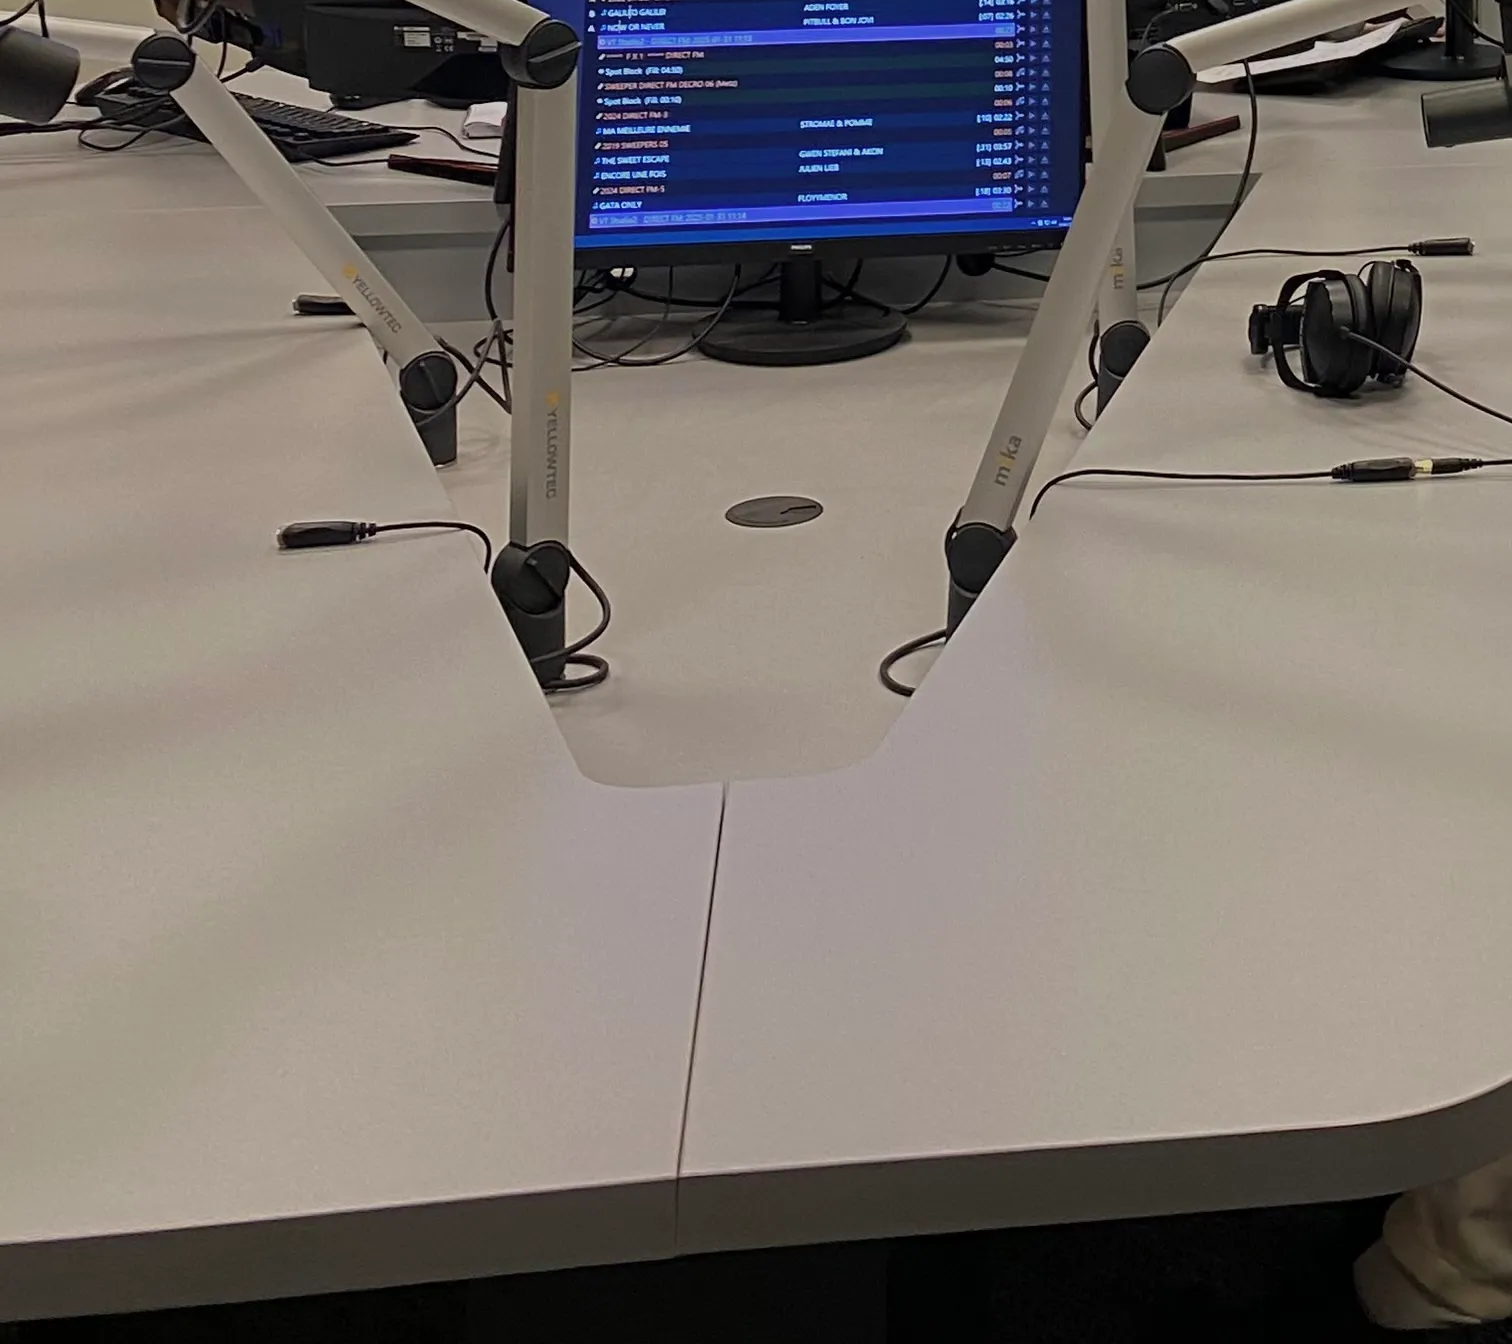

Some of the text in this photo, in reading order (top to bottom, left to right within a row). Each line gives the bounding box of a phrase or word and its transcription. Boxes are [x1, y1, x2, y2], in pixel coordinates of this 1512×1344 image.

[628, 23, 640, 31] OR
[641, 22, 666, 31] NEVER
[665, 51, 705, 60] DIRECT FM
[604, 82, 637, 91] SWEEPER
[638, 81, 665, 90] DIRECT
[665, 80, 678, 89] FM
[622, 112, 648, 120] DIRECT
[603, 127, 616, 136] MA
[617, 156, 641, 165] SWEET
[642, 154, 670, 164] ESCAPE
[601, 170, 631, 180] ENCORE
[619, 185, 645, 194] DIRECT
[599, 200, 643, 210] GATA ONLY
[352, 273, 402, 334] YELLOWTEC
[545, 407, 558, 500] YELLOWTEC
